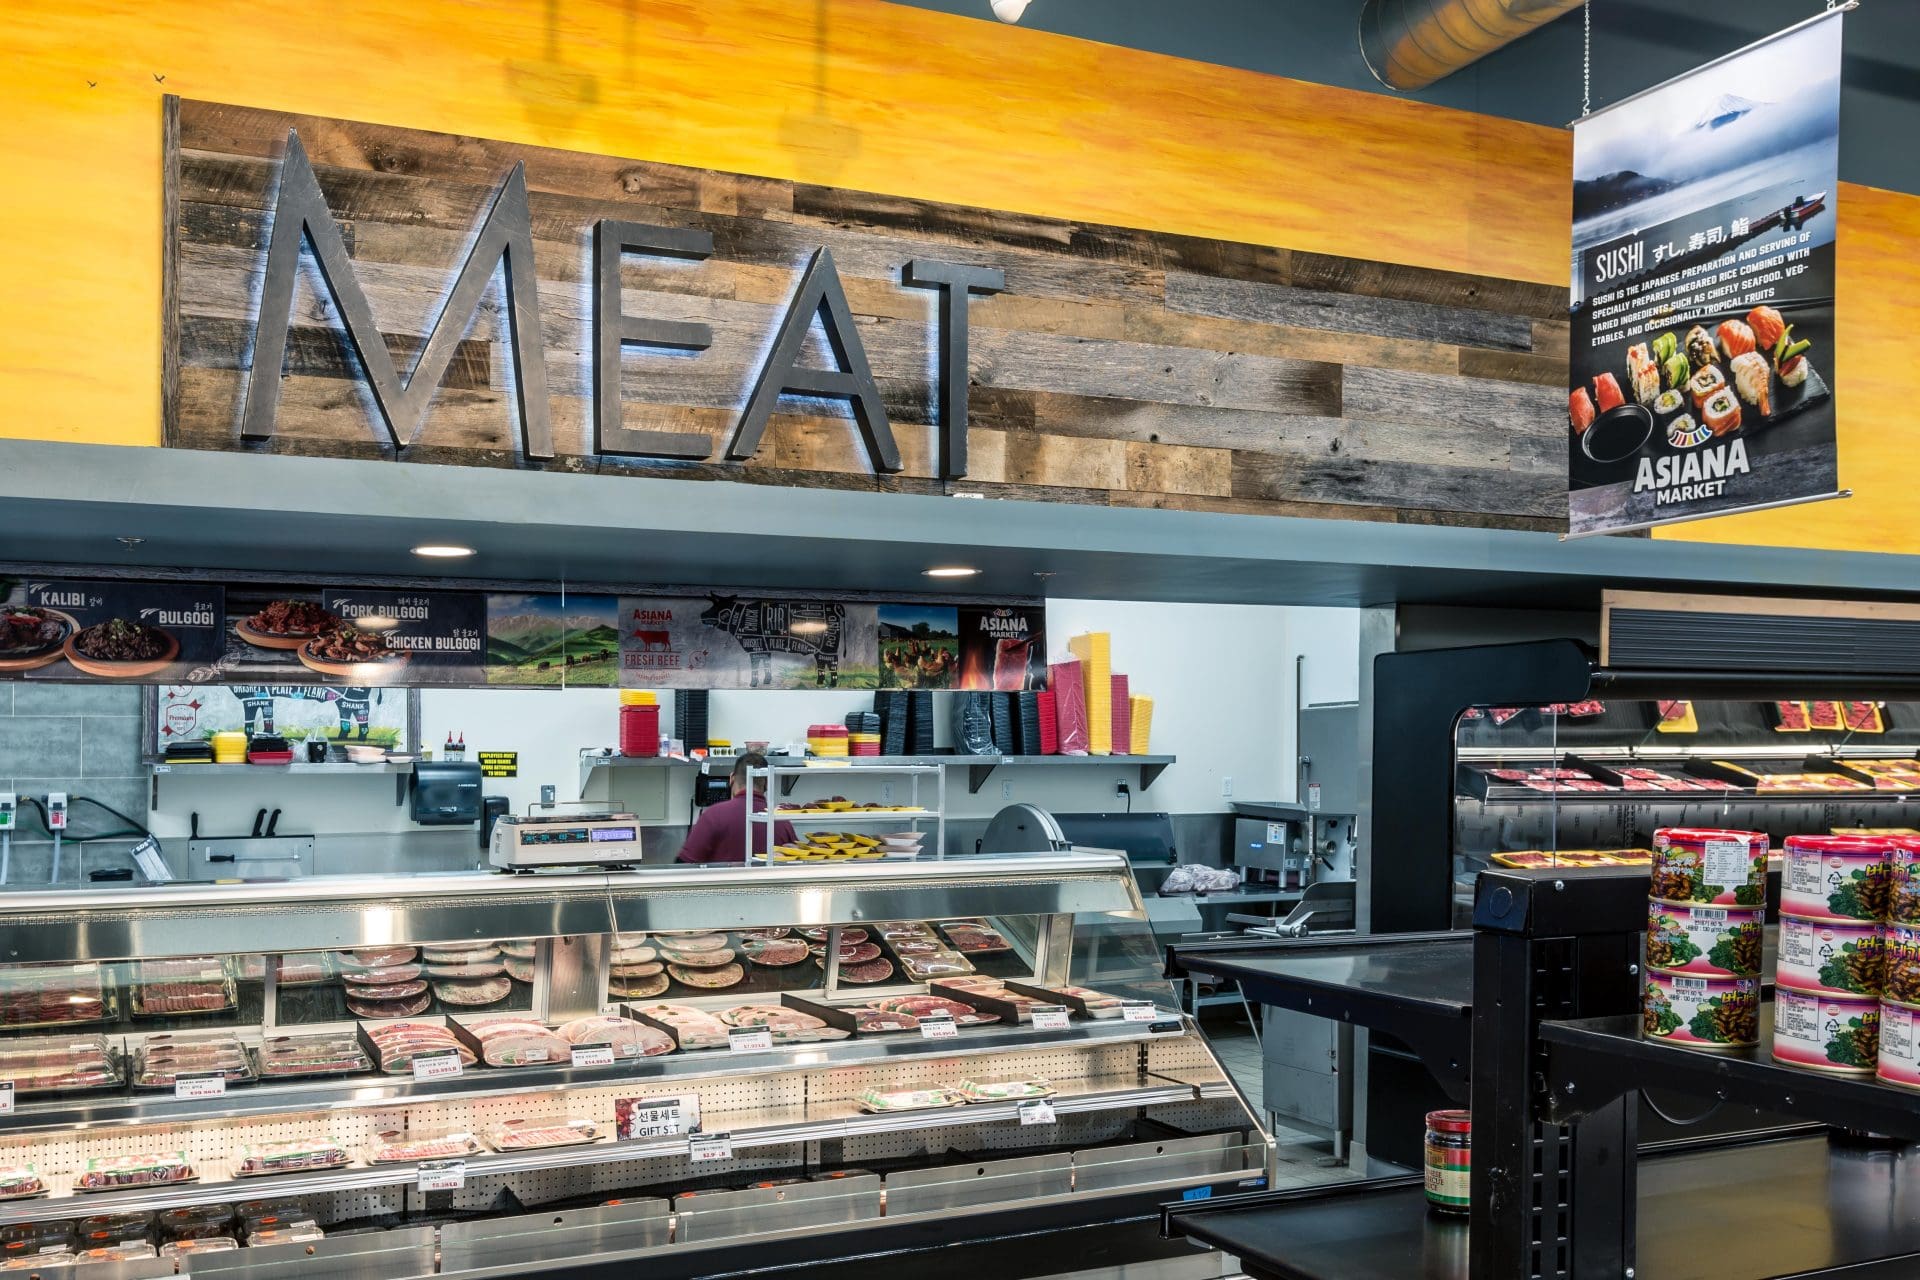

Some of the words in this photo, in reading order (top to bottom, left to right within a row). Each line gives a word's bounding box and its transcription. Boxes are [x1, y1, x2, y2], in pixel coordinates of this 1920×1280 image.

[1592, 292, 1615, 306] SUSHI
[1616, 290, 1624, 299] IS
[1626, 284, 1640, 296] THE
[1641, 272, 1680, 291] JAPANESE
[1681, 254, 1736, 279] PREPARATION
[1738, 248, 1757, 261] AND
[1759, 235, 1797, 255] SERVING
[1799, 231, 1811, 243] OF
[1595, 240, 1644, 283] SUSHI
[1592, 301, 1630, 320] SPECIALLY
[1632, 289, 1670, 308] PREPARED
[1672, 275, 1717, 296] VINEGARED
[1719, 269, 1737, 282] RICE
[1739, 254, 1784, 276] COMBINED
[1786, 247, 1810, 262] WITH
[241, 126, 1005, 479] MEAT
[1592, 319, 1619, 333] VARIED
[1620, 303, 1672, 324] INGREDIENTS
[1670, 296, 1691, 311] SUCH
[1693, 292, 1705, 304] AS
[1707, 282, 1739, 300] CHIEFLY
[1785, 264, 1809, 278] VEG-
[1627, 325, 1643, 337] AND
[1644, 308, 1702, 332] OCCASIONALLY
[1704, 296, 1743, 315] TROPICAL
[1744, 287, 1775, 303] FRUITS
[1633, 438, 1750, 492] ASIANA
[1656, 479, 1726, 505] MARKET
[41, 591, 85, 606] KALIBI
[159, 610, 215, 625] BULGOGI
[342, 604, 374, 618] PORK
[378, 606, 429, 619] BULGOGI
[633, 608, 673, 620] ASIANA
[766, 607, 785, 630] RIB
[980, 616, 1029, 632] ASIANA
[385, 636, 432, 650] CHICKEN
[435, 637, 481, 650] BULGOGI
[769, 638, 785, 649] PLATE
[625, 654, 654, 666] FRESH
[657, 654, 681, 666] BEEF
[303, 686, 328, 700] FLANK
[247, 700, 270, 708] SHANK
[341, 701, 365, 710] SHANK
[638, 1108, 680, 1123] 선물세트
[639, 1126, 660, 1137] GIFT
